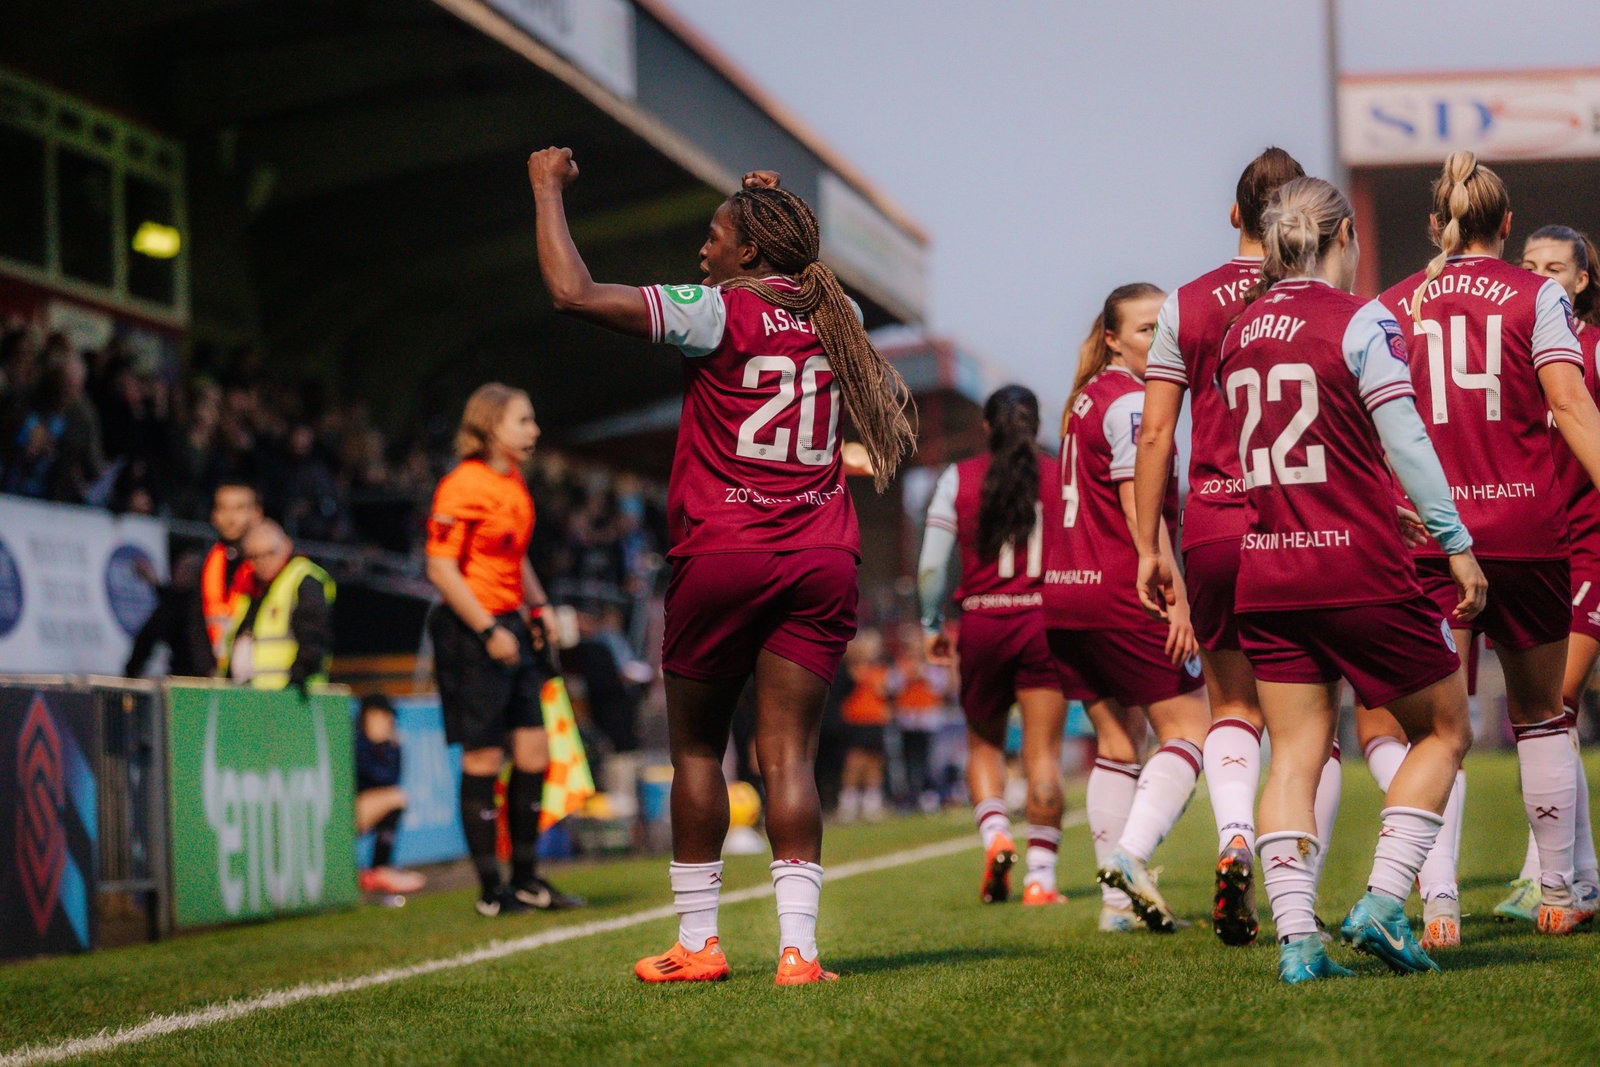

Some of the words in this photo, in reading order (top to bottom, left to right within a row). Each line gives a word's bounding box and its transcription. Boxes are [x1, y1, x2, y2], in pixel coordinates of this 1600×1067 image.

[1212, 278, 1261, 307] TYS
[761, 308, 817, 337] ASSE
[1240, 314, 1306, 348] GORRY
[1413, 314, 1502, 425] 14
[735, 355, 840, 466] 20
[1226, 362, 1327, 490] 22
[1225, 478, 1247, 493] SKI
[1451, 486, 1469, 500] IN
[1472, 483, 1536, 500] HEALTH
[1281, 530, 1351, 549] HEALTH
[1012, 591, 1043, 607] HEA
